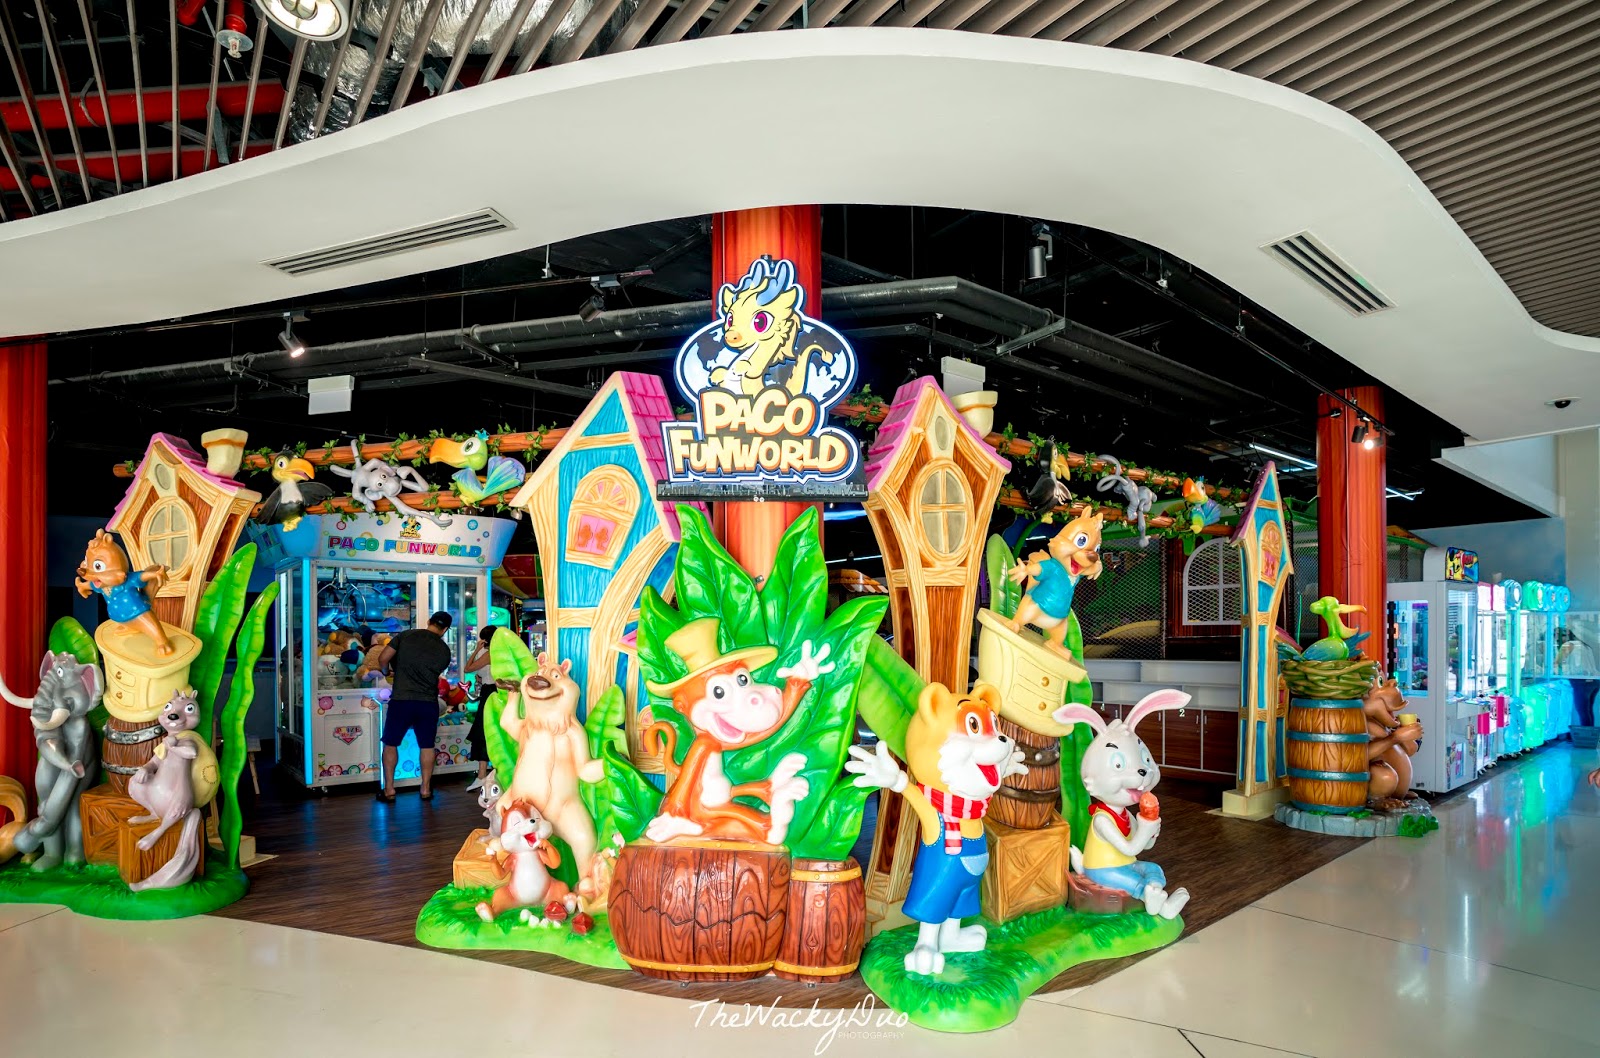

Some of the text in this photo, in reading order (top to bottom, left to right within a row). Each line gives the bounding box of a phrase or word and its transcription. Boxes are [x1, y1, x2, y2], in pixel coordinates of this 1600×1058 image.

[702, 391, 816, 436] PACO
[669, 429, 848, 472] FUNWORLD
[328, 536, 482, 557] PACO FUNWORLD
[1179, 708, 1185, 717] 2
